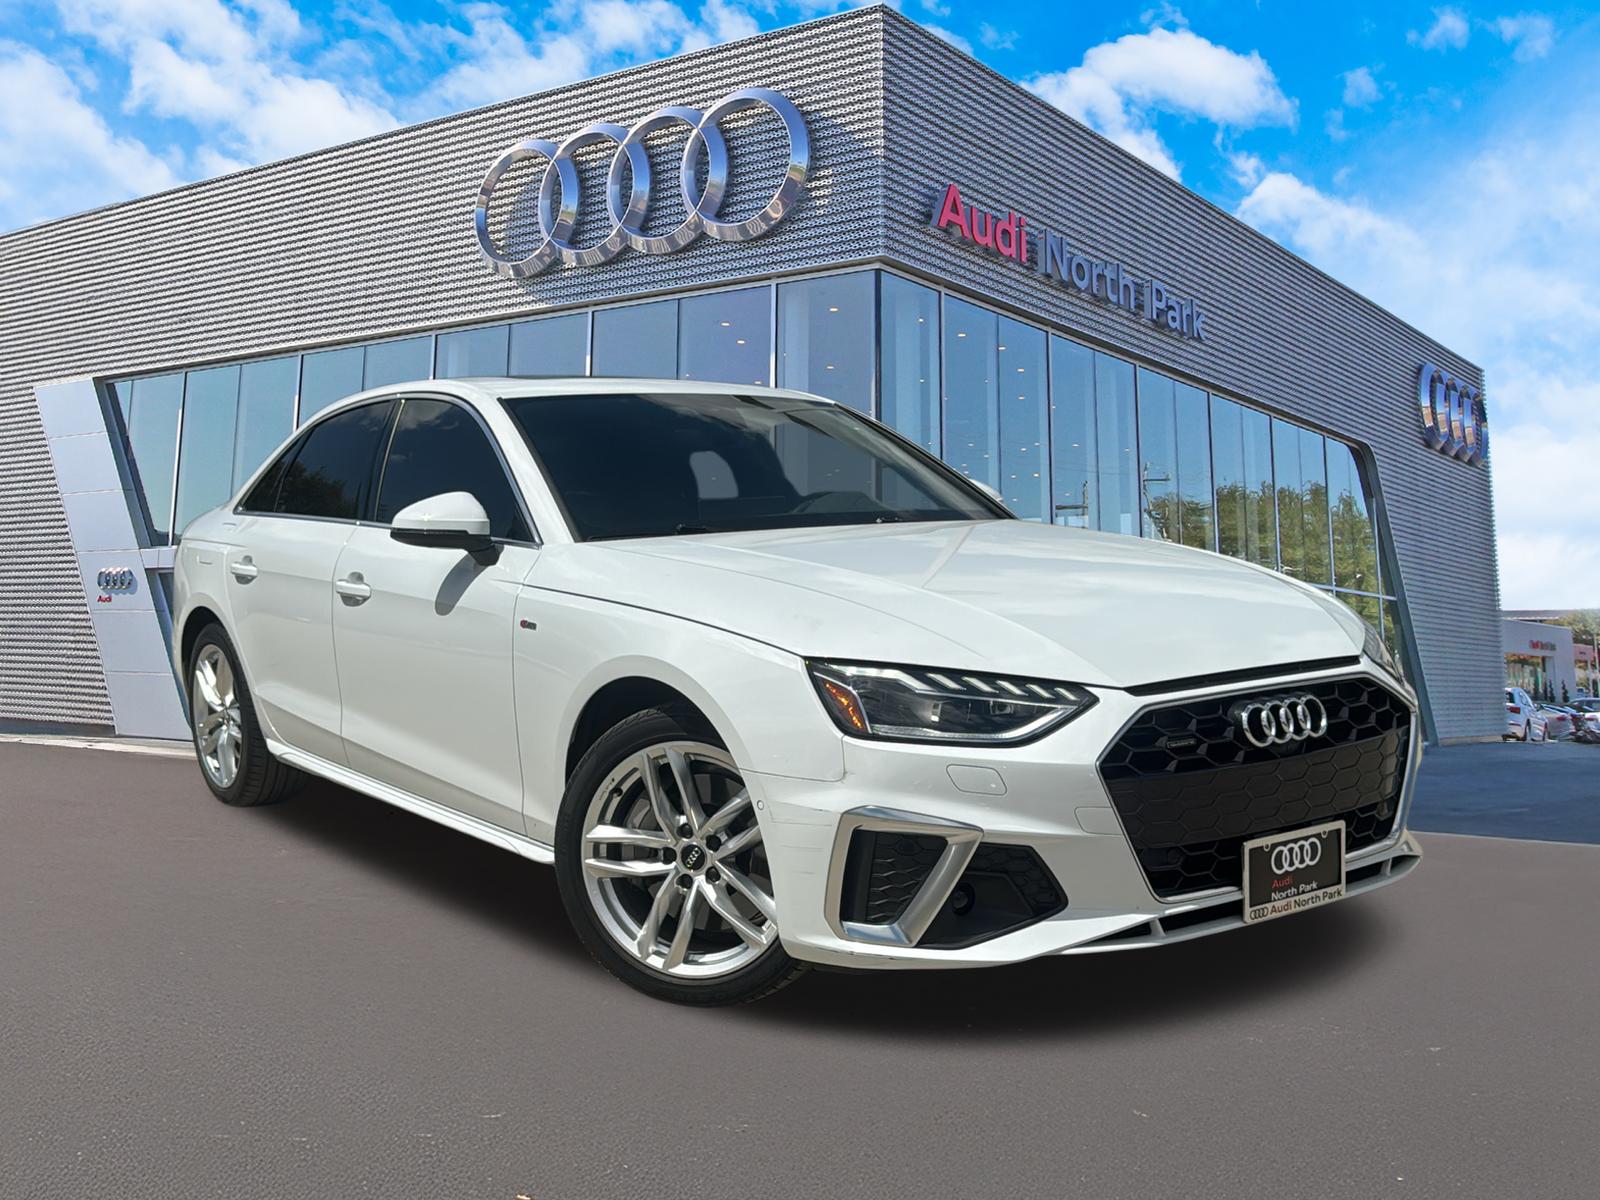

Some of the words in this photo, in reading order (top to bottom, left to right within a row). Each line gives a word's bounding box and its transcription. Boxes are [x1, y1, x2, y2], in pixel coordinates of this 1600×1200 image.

[932, 183, 1028, 263] Audi
[1040, 230, 1136, 313] North
[1145, 278, 1207, 341] Park
[1271, 888, 1297, 901] North
[1299, 880, 1318, 893] Park
[1272, 876, 1293, 889] Audi
[1270, 901, 1292, 915] Audi
[1294, 894, 1321, 908] North
[1322, 888, 1342, 901] Park
